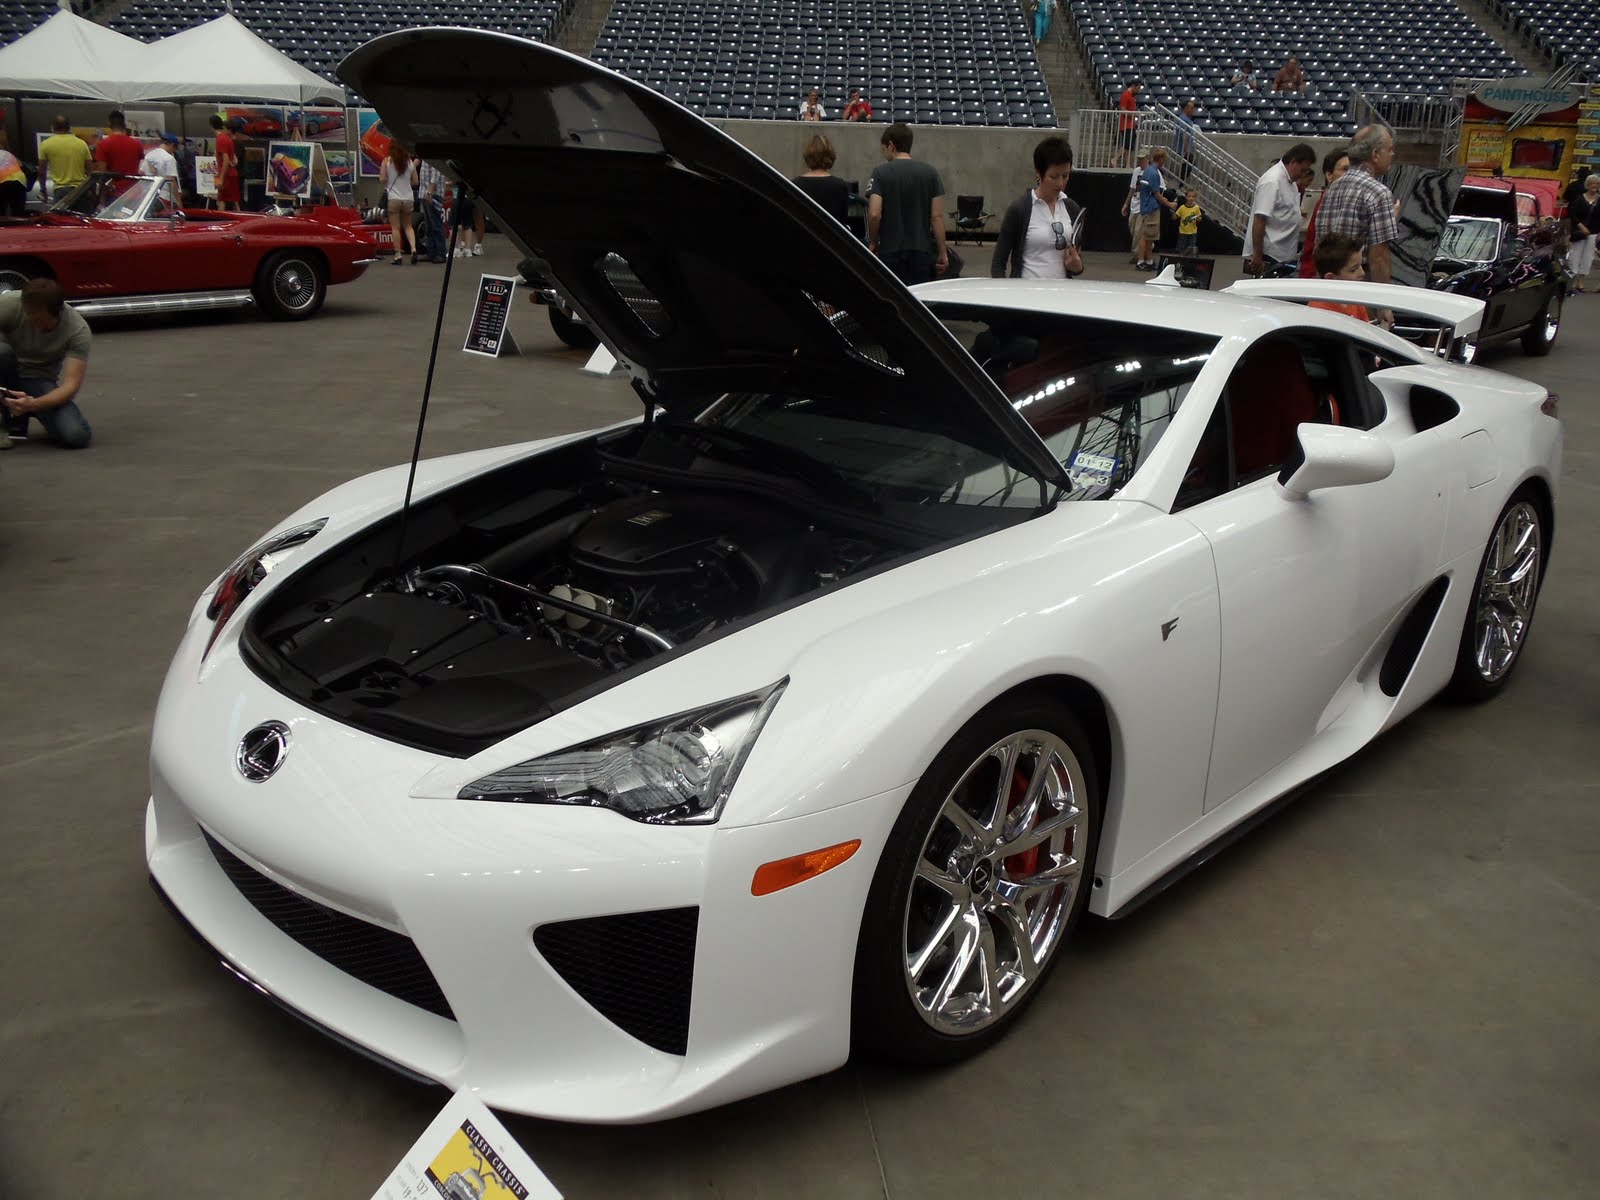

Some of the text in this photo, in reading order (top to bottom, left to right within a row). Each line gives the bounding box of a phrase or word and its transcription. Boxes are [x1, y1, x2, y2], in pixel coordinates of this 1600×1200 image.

[1484, 88, 1570, 103] PAINTHOUSE
[489, 285, 504, 293] 1967
[466, 1125, 524, 1196] CLASSY CHASSIS
